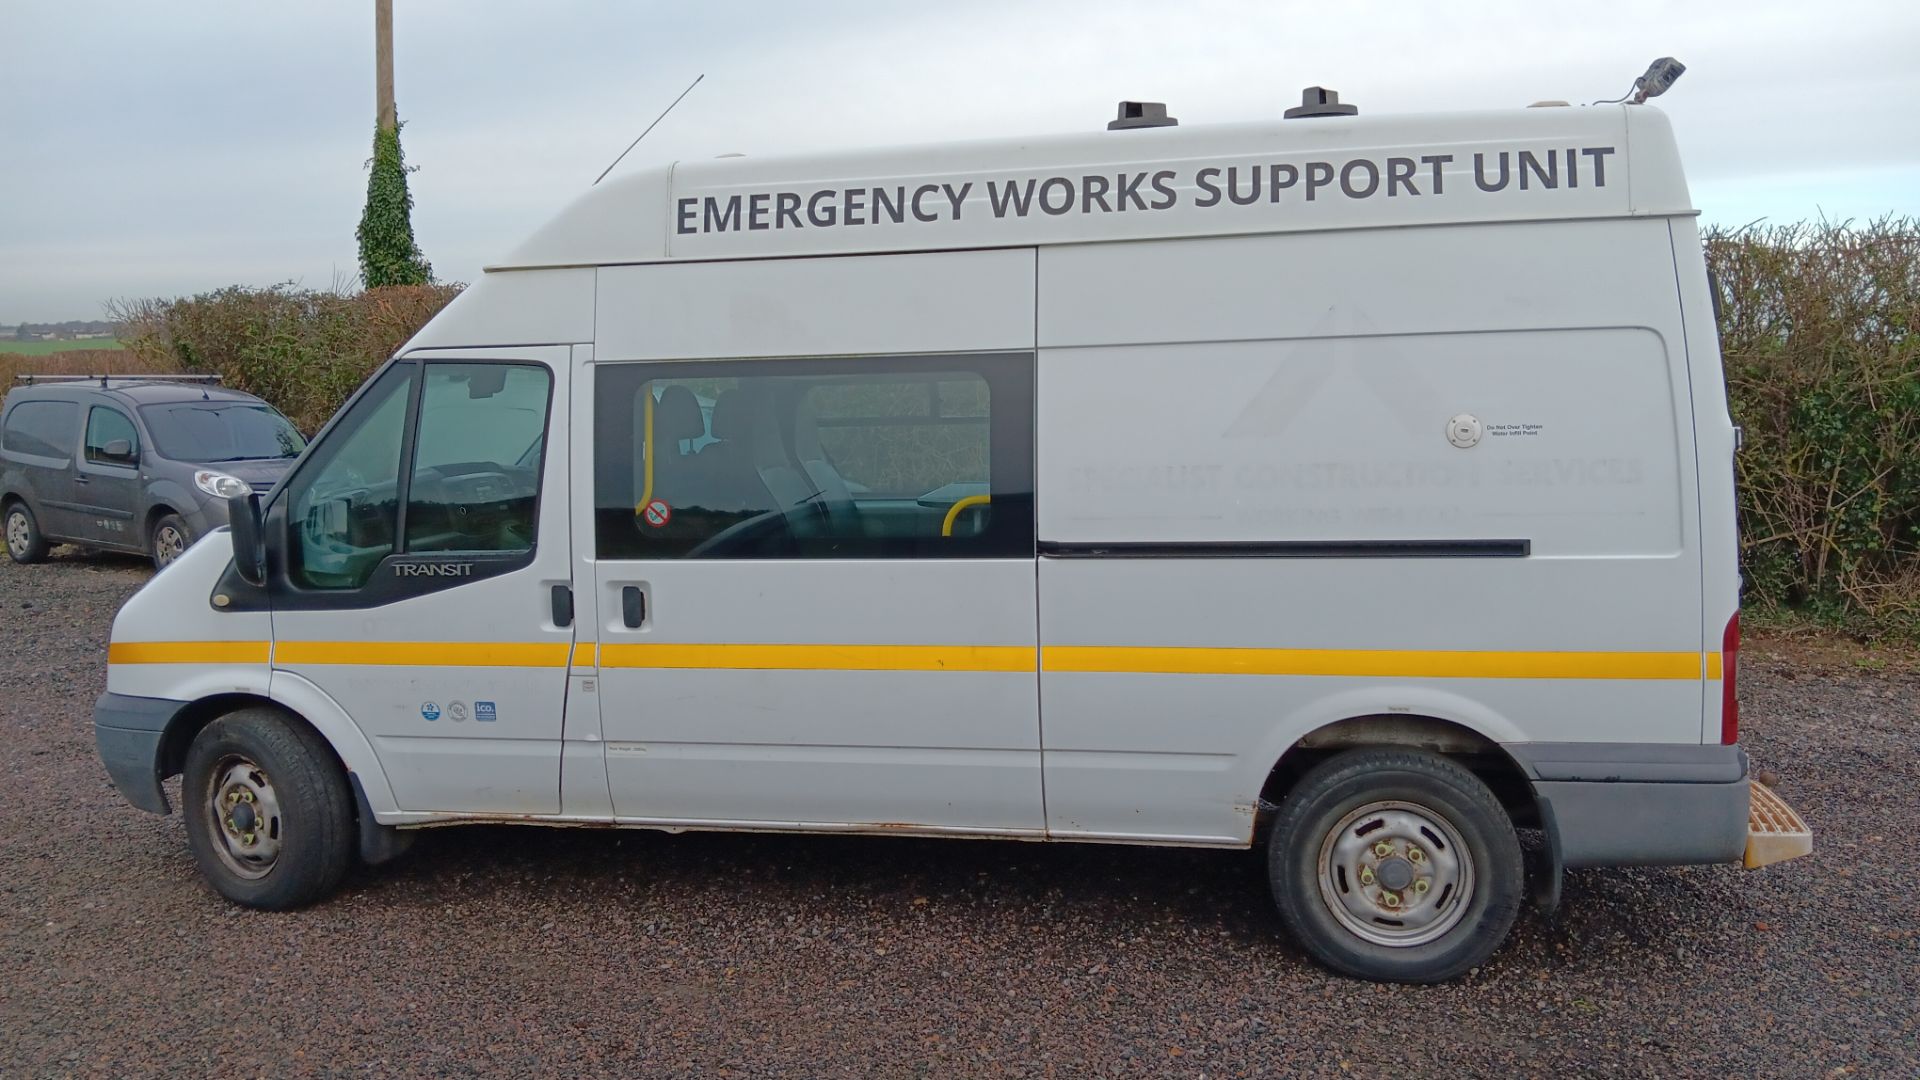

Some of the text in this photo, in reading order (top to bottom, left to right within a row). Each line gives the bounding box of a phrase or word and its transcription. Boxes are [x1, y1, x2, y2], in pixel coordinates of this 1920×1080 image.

[676, 146, 1615, 235] EMERGENCY WORKS SUPPORT UNIT
[1235, 460, 1481, 490] CONSTRUCTION
[1498, 458, 1643, 488] SERVICES
[391, 563, 473, 577] TRANSIT
